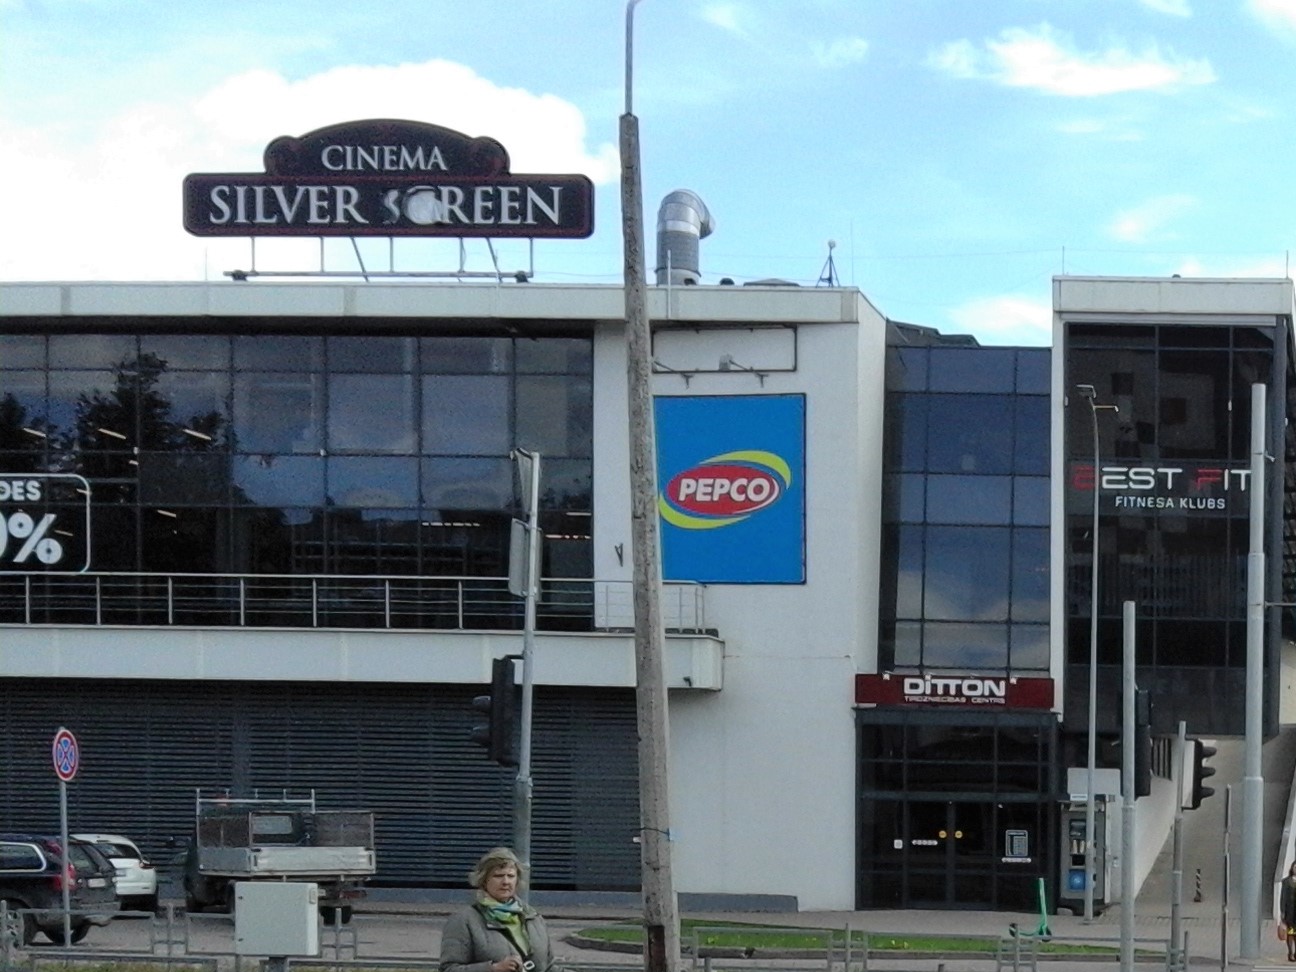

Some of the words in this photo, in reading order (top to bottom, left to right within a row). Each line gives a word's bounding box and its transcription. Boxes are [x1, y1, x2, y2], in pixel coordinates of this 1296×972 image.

[321, 145, 448, 171] CINEMA
[209, 185, 369, 225] SILVER
[678, 477, 770, 502] PEPCO
[1072, 466, 1183, 490] BEST
[1195, 467, 1251, 491] FIT
[1115, 495, 1174, 508] FITNESA
[1179, 498, 1226, 509] KLUBS
